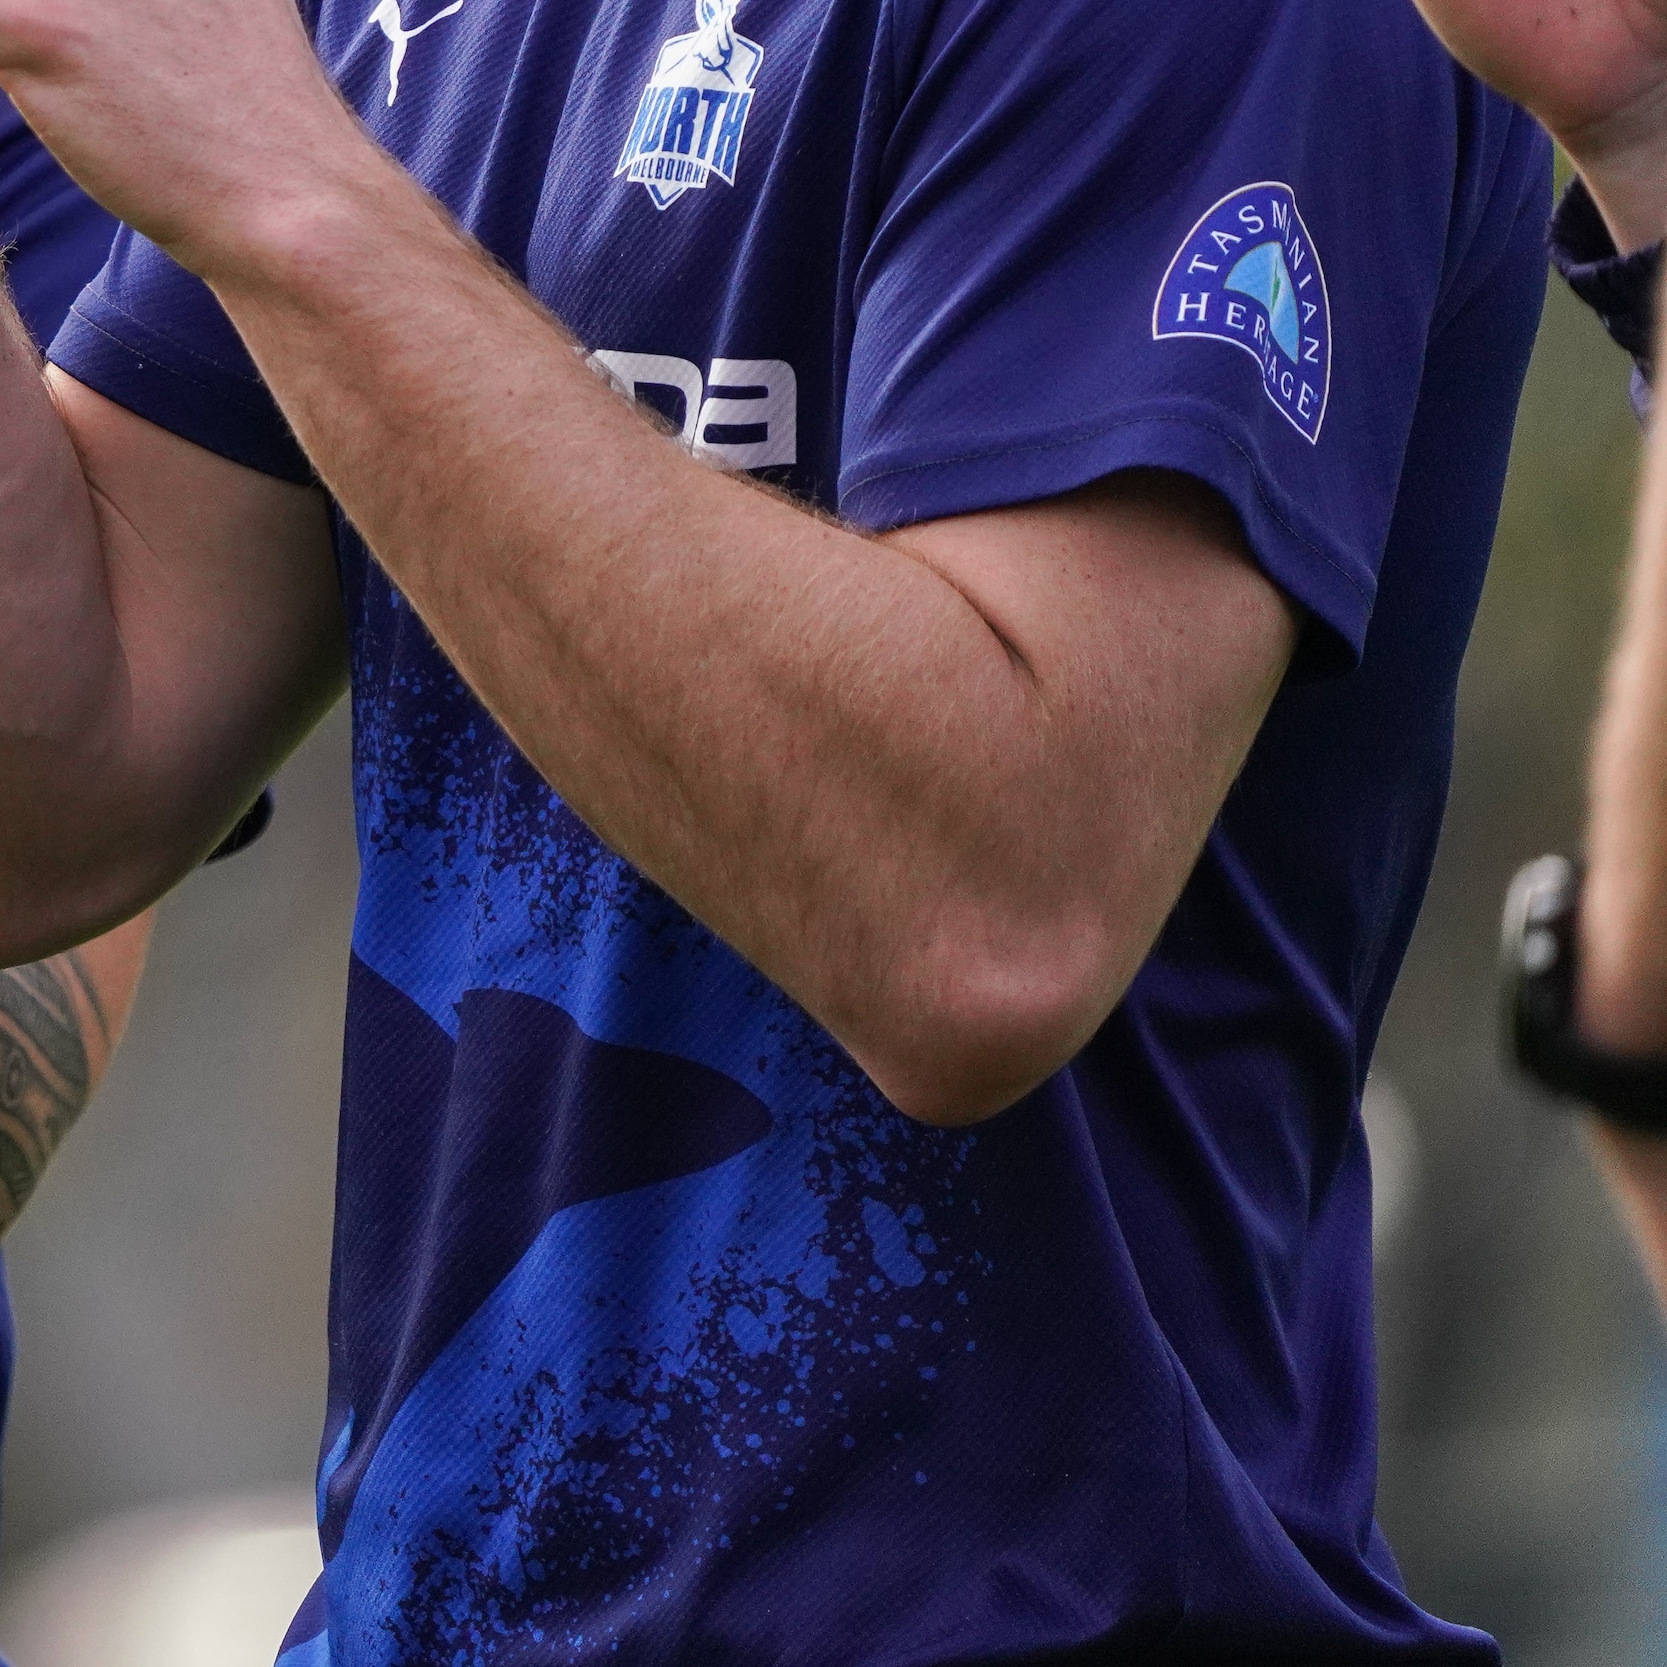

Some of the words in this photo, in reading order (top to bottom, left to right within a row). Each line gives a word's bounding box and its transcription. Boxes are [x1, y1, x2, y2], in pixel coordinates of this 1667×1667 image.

[619, 86, 752, 181] NORTH
[630, 156, 708, 182] MELBOURNE
[1176, 292, 1313, 420] HERAGE
